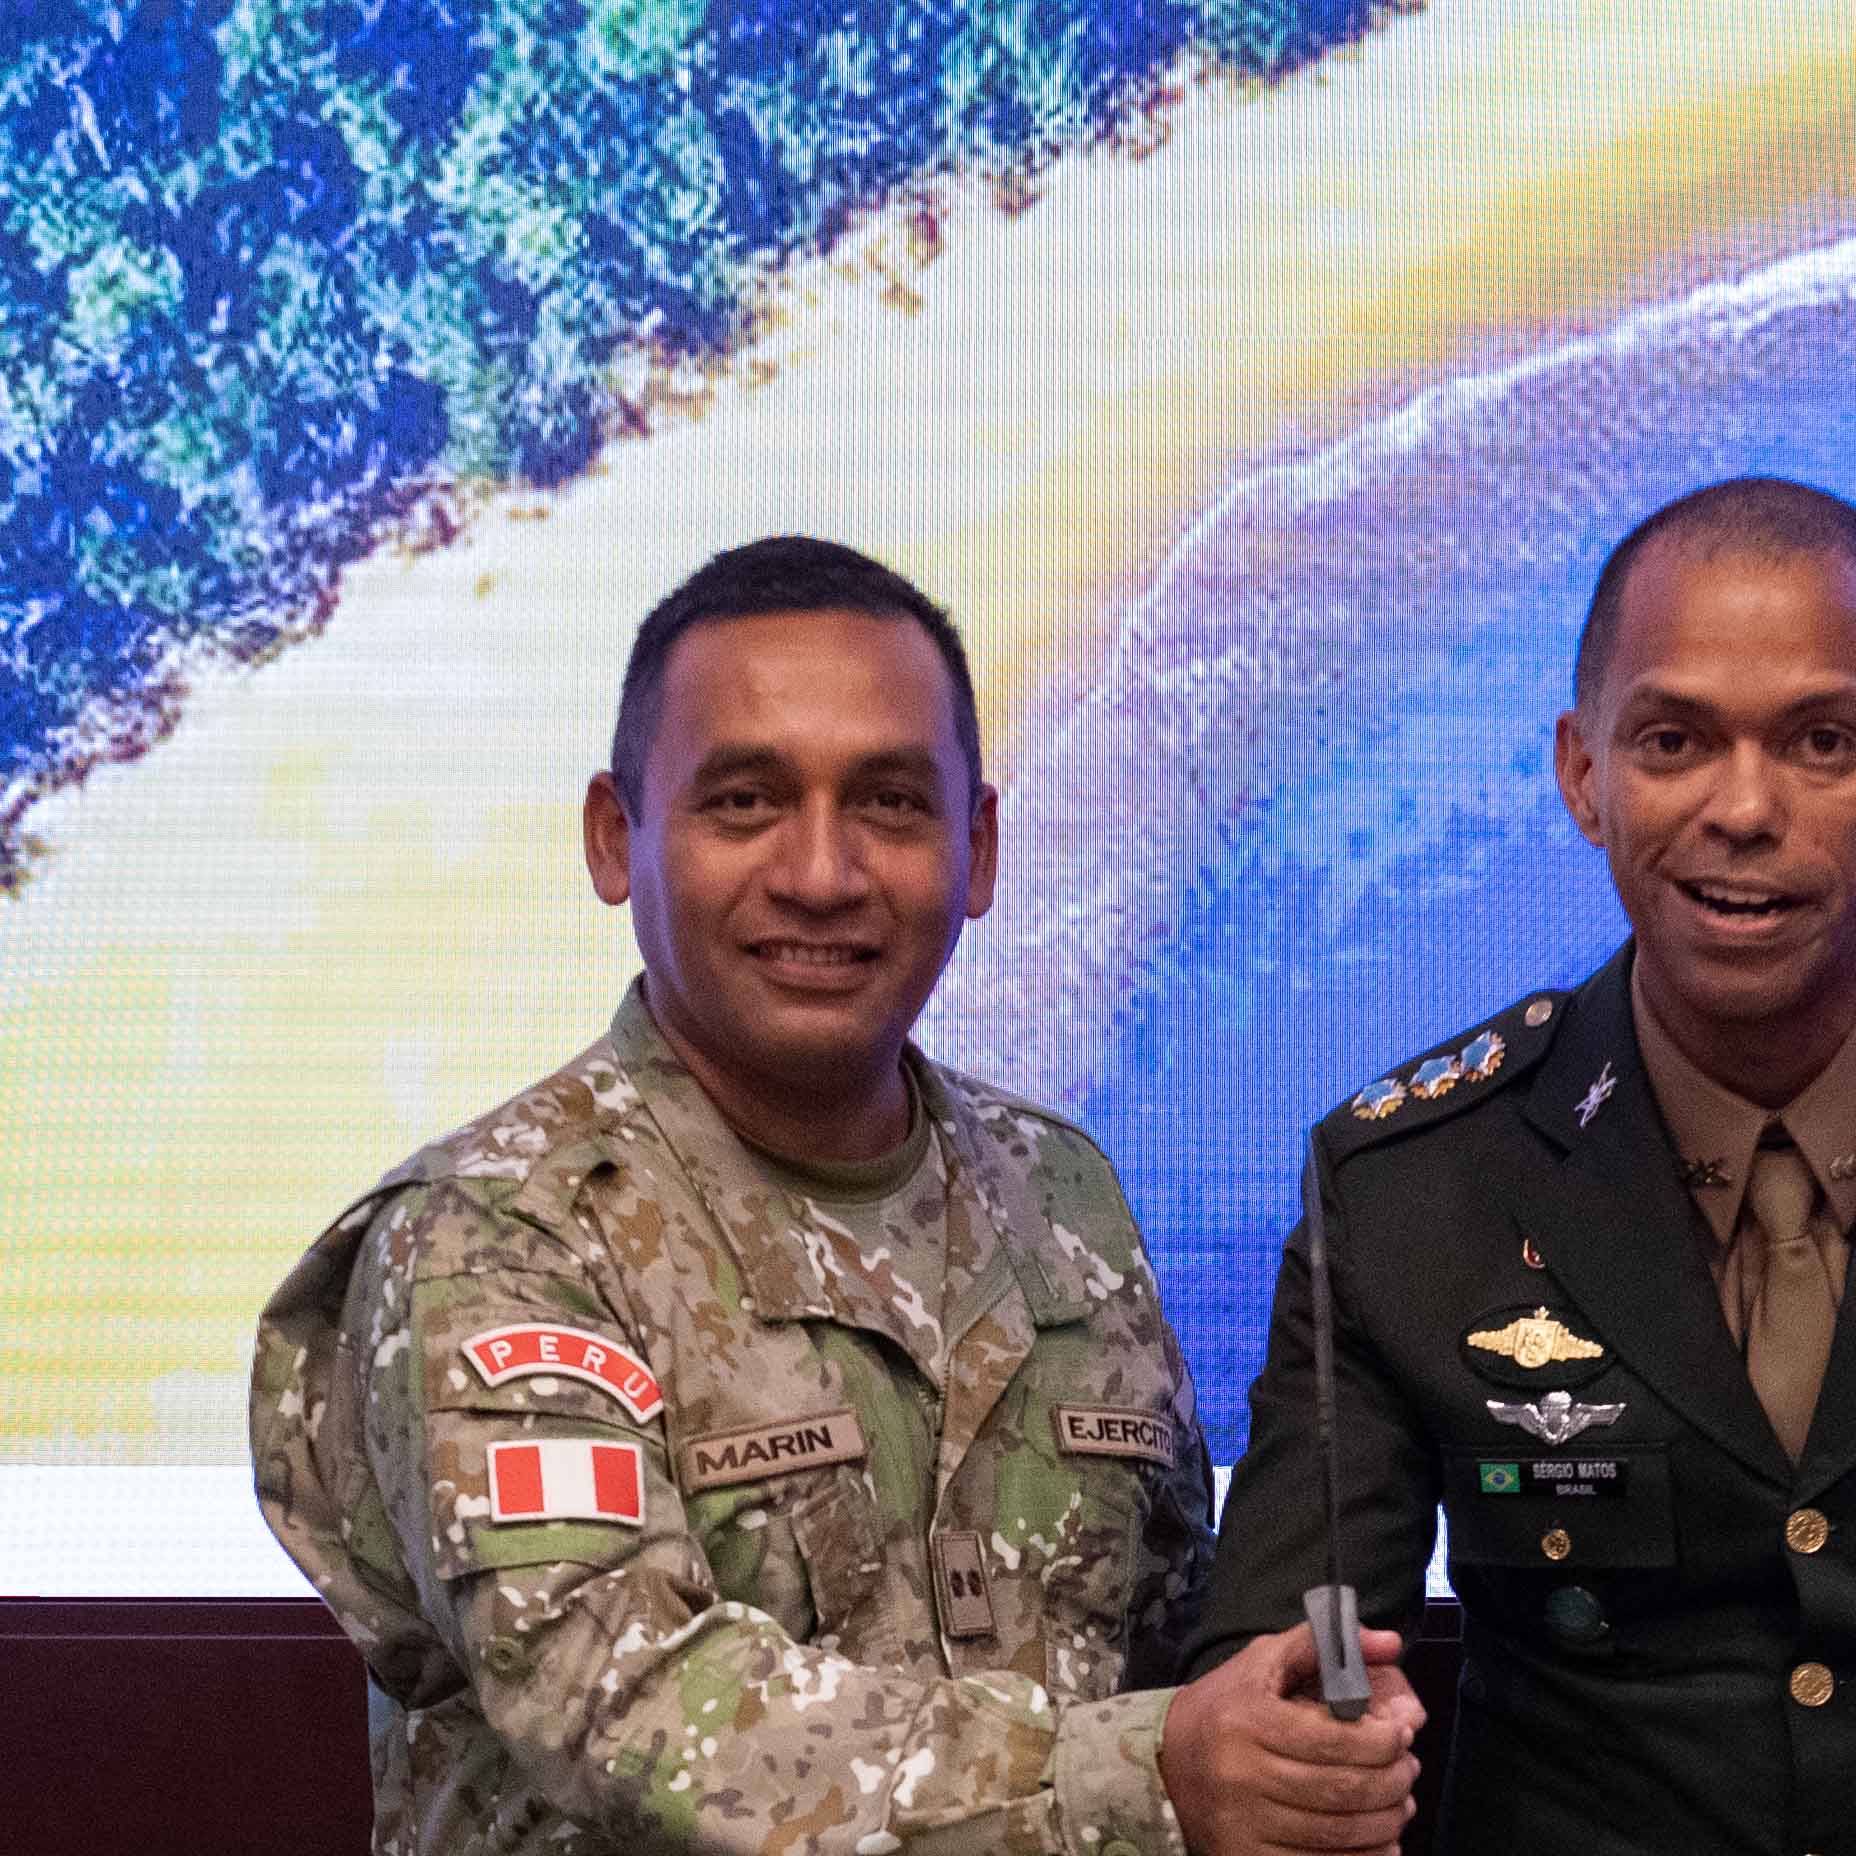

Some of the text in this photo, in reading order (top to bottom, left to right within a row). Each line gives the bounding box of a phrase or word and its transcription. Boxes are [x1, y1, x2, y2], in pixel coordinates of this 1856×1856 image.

[488, 1335, 649, 1399] PERU
[696, 1424, 834, 1475] MARIN
[1067, 1415, 1171, 1456] EJERCITO
[1577, 1463, 1617, 1479] MATOS
